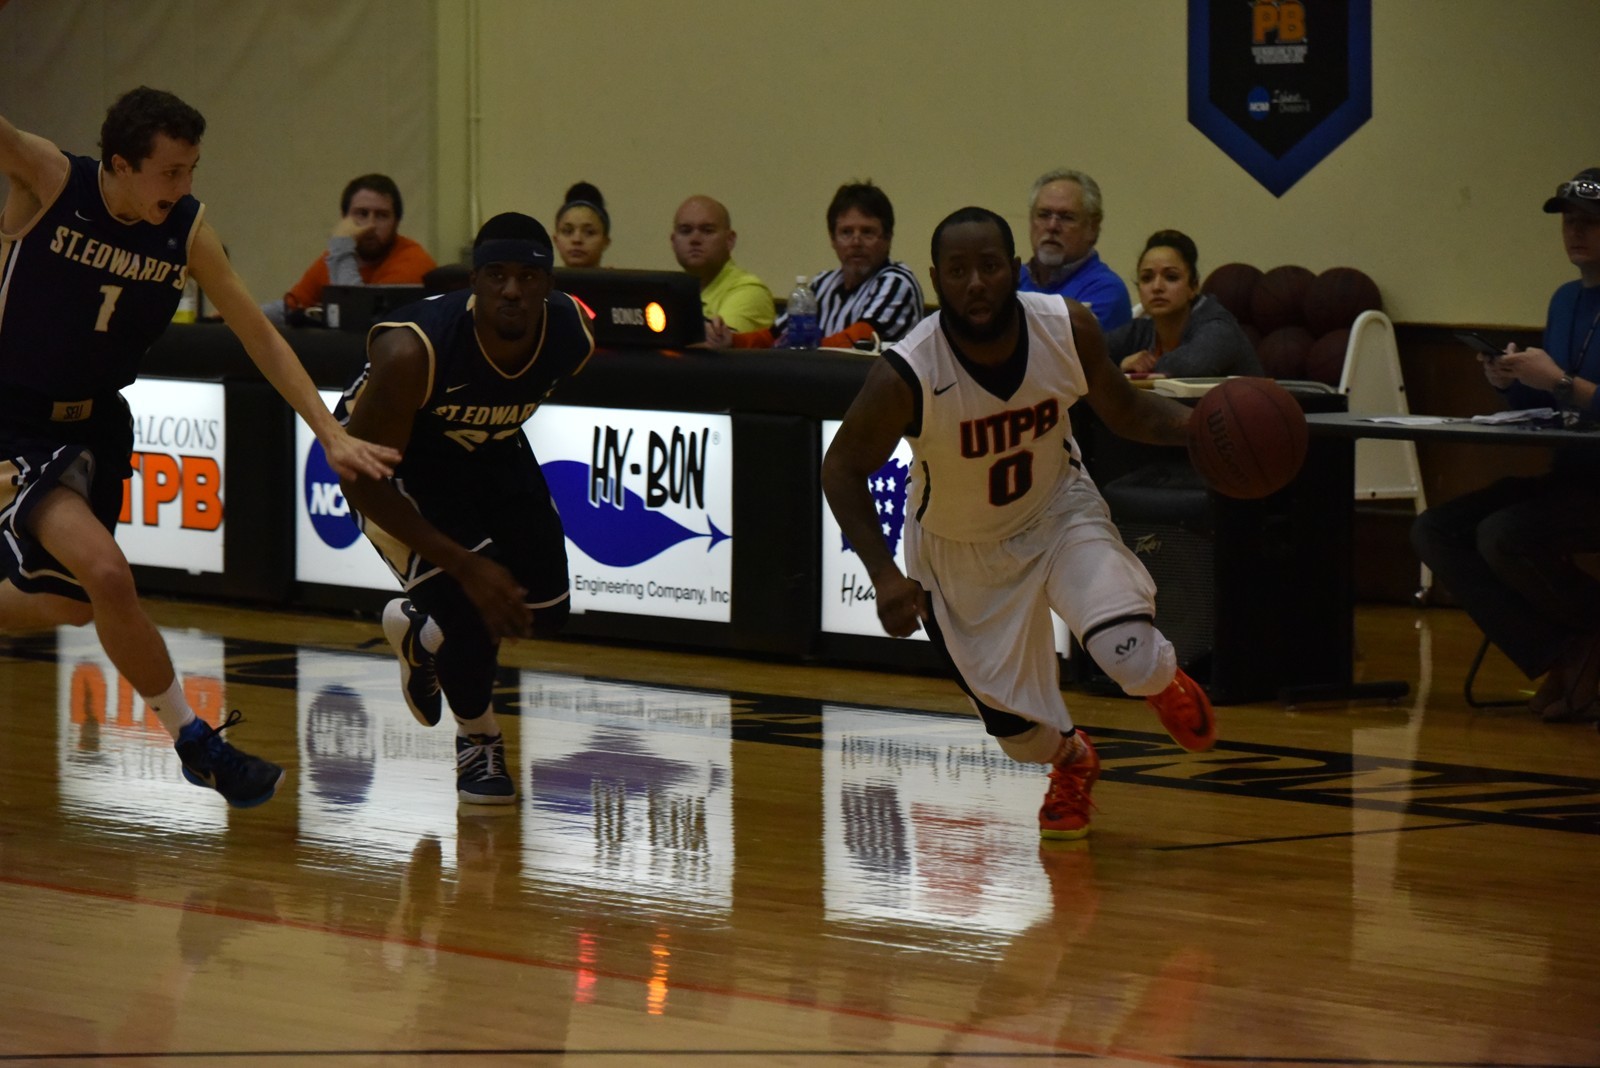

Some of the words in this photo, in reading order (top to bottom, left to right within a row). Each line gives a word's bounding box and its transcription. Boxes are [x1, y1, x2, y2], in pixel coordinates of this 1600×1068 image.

[94, 284, 124, 332] 1
[611, 307, 645, 326] BONUS
[134, 416, 218, 450] ALCONS
[960, 397, 1060, 459] UTPB
[590, 425, 710, 510] HY-BON
[989, 449, 1034, 507] 0
[118, 451, 224, 532] TPB
[310, 481, 351, 517] NC
[575, 575, 645, 600] Engineering
[647, 581, 708, 605] Company,
[711, 586, 730, 603] Inc
[841, 572, 877, 607] Hea
